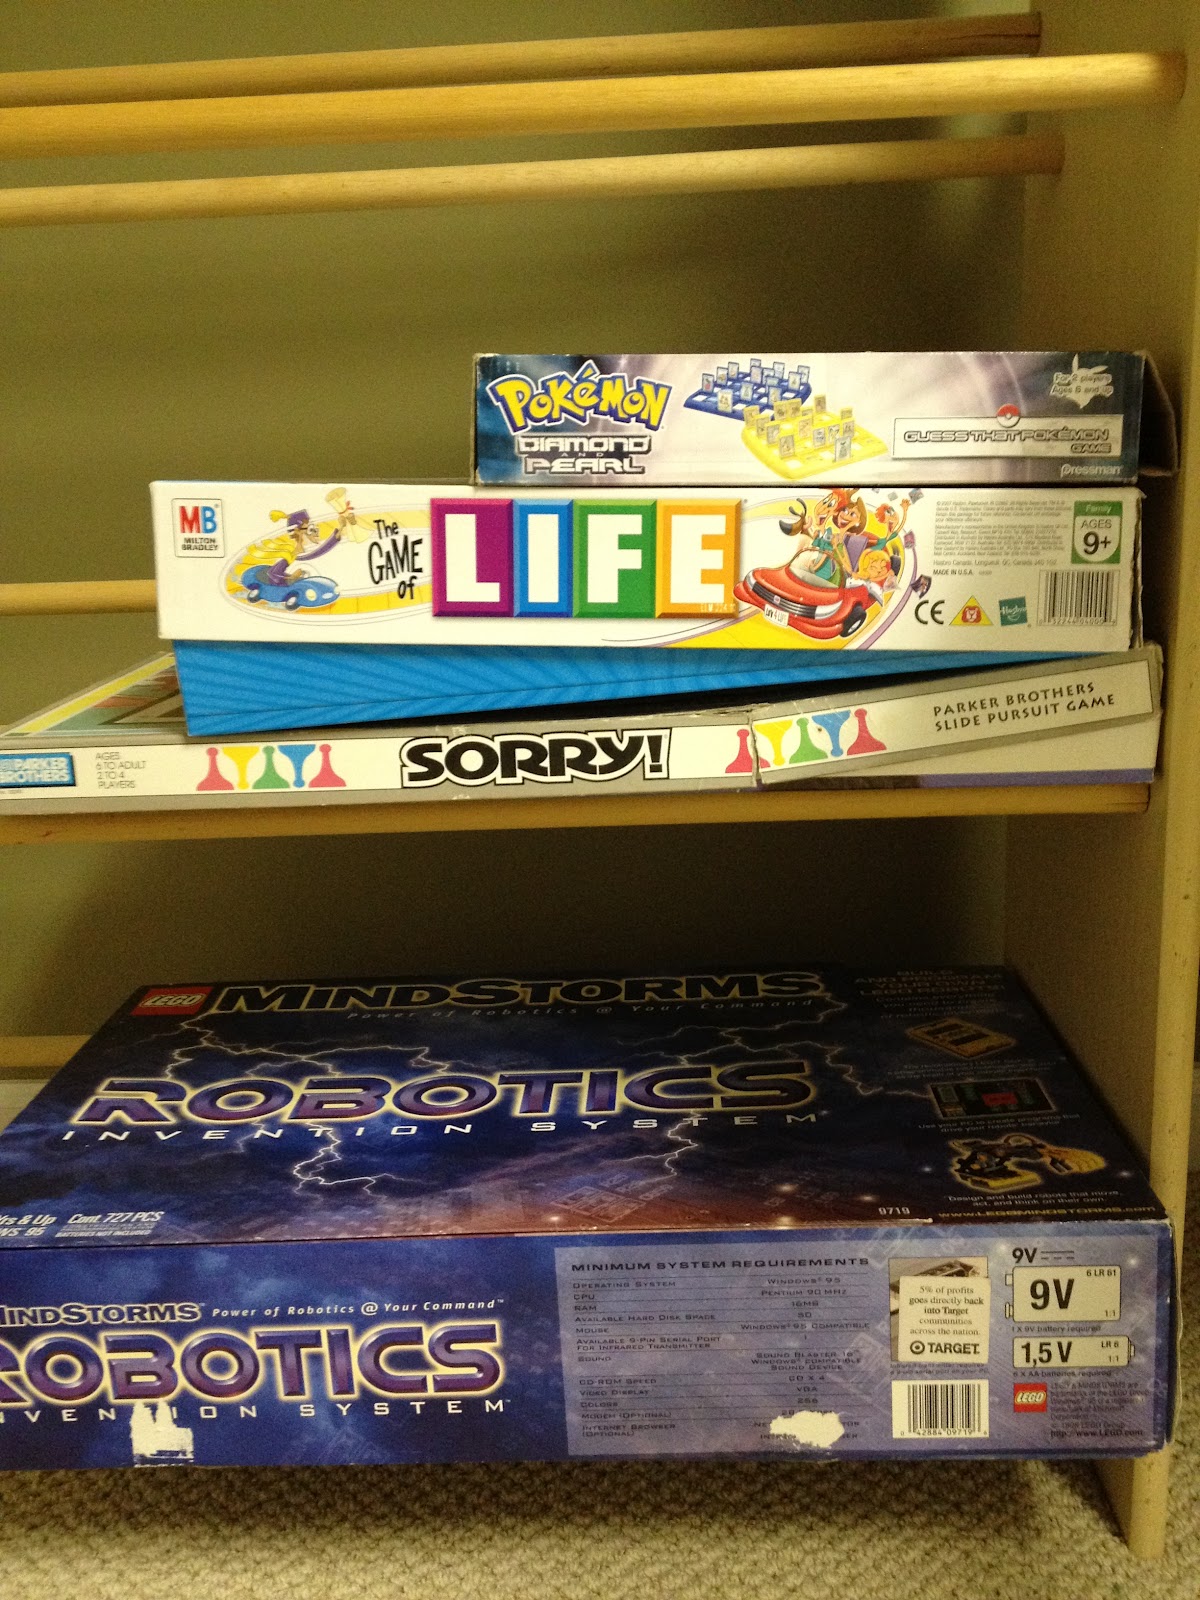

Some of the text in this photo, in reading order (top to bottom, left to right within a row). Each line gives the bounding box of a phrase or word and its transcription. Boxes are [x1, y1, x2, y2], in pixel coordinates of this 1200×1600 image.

[1055, 373, 1111, 383] For 2 players
[1053, 385, 1072, 394] Ages
[1084, 385, 1099, 393] and
[904, 430, 968, 442] GUESS
[516, 435, 652, 454] DIAMOND
[1071, 442, 1112, 453] GAME
[525, 457, 645, 474] PEARL
[180, 506, 218, 533] MB
[1080, 518, 1112, 529] AGES
[373, 519, 399, 538] The
[1083, 531, 1112, 555] 9+
[444, 512, 727, 605] LIFE
[397, 576, 418, 600] of
[934, 681, 1095, 717] PARKER BROTHERS
[935, 694, 1115, 732] SLIDE PURSUIT GAME
[95, 752, 120, 761] AGES
[401, 728, 669, 787] SORRY!
[104, 760, 146, 770] TO ADULT
[97, 771, 103, 780] 2
[104, 771, 116, 779] TO
[98, 780, 136, 790] PLAYERS
[140, 993, 206, 1008] LEGO
[346, 1011, 416, 1020] Power
[70, 1058, 820, 1125] ROBOTICS
[62, 1113, 817, 1142] INVENTION SYSTEM
[1007, 1192, 1031, 1200] build
[1034, 1191, 1067, 1199] robots
[1069, 1190, 1089, 1198] that
[1015, 1197, 1039, 1205] think
[1058, 1196, 1080, 1204] their
[103, 1212, 136, 1223] 727
[132, 1210, 165, 1222] PCS
[878, 1206, 910, 1216] 9719
[17, 1214, 33, 1225] &
[32, 1214, 58, 1227] Up
[24, 1226, 48, 1237] 95
[1012, 1247, 1038, 1263] 9V
[572, 1258, 869, 1272] MINIMUM SYSTEM REQUIREMENTS
[919, 1285, 974, 1296] 5% of profits
[1030, 1278, 1075, 1310] 9V
[908, 1296, 984, 1306] goes directly back
[212, 1307, 257, 1318] Power
[264, 1305, 280, 1317] of
[288, 1304, 355, 1316] Robotics
[361, 1301, 379, 1316] @
[384, 1302, 418, 1313] Your
[924, 1306, 968, 1316] into Target
[919, 1317, 972, 1326] communities
[1037, 1324, 1065, 1333] battery
[1067, 1323, 1102, 1333] required
[938, 1326, 950, 1335] the
[927, 1342, 980, 1355] TARGET
[1016, 1391, 1047, 1404] LEGO
[299, 1399, 504, 1418] SYSTEM
[946, 1428, 973, 1436] 09719
